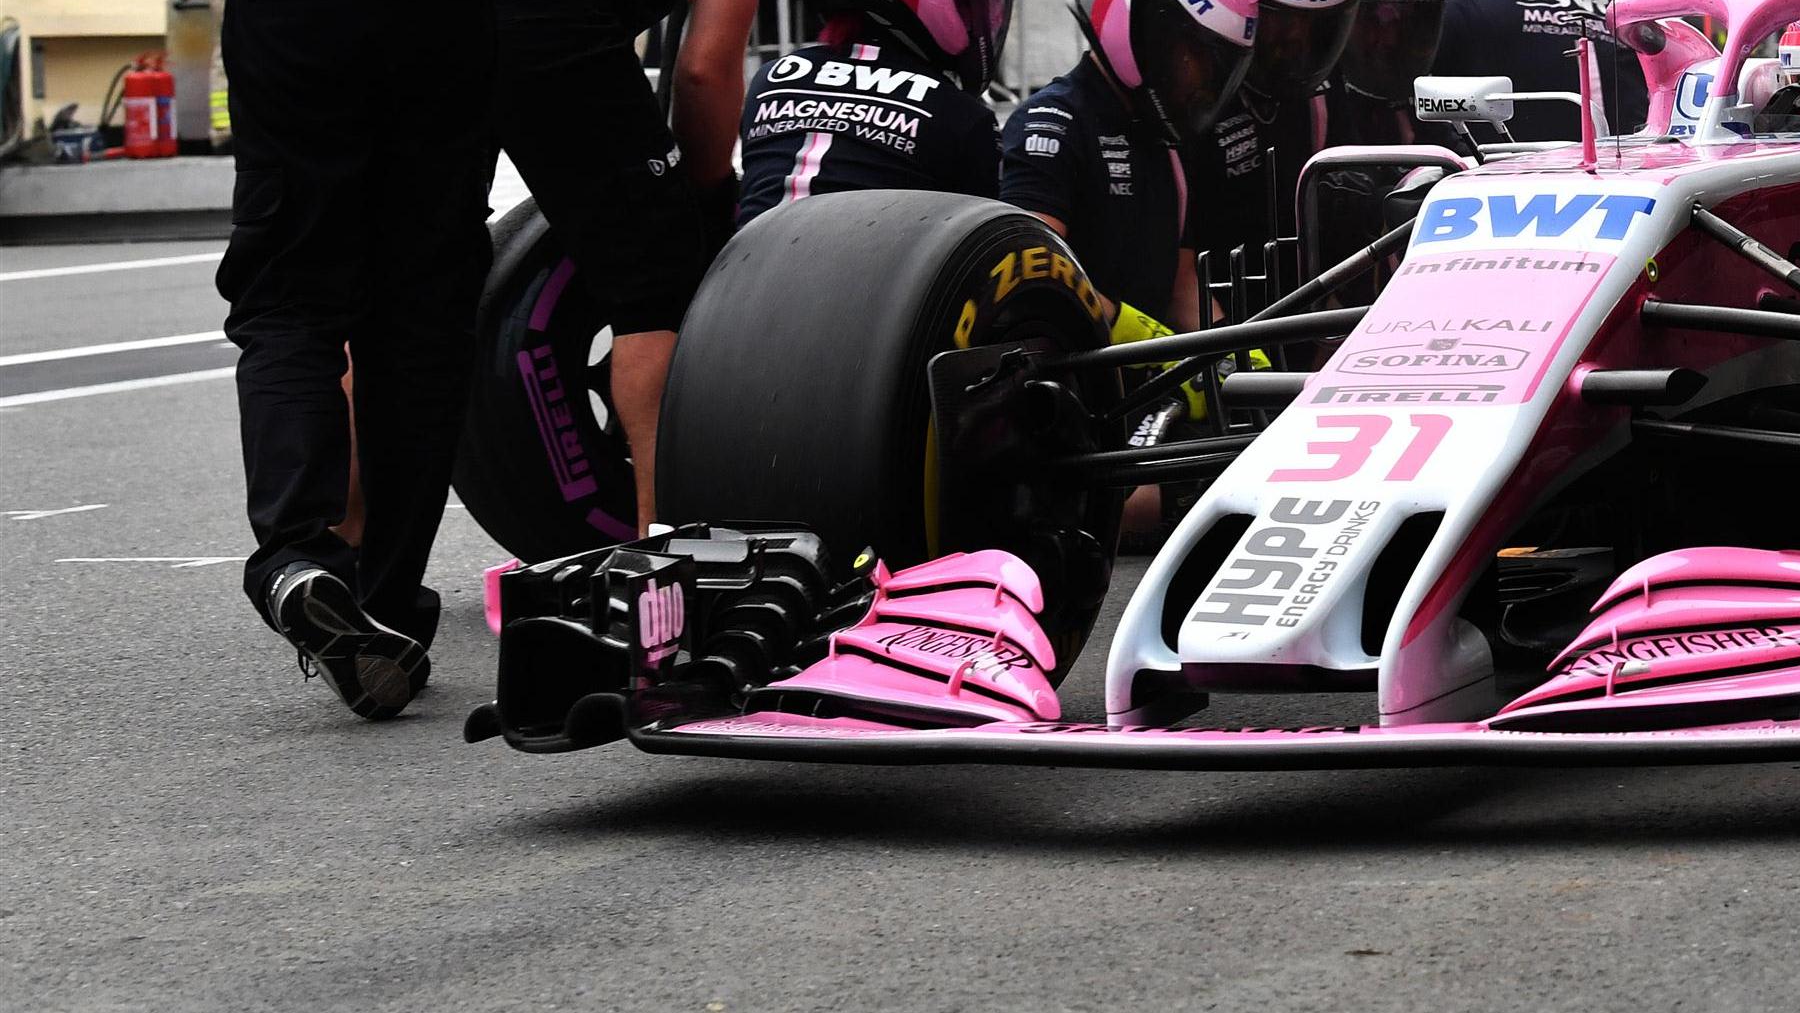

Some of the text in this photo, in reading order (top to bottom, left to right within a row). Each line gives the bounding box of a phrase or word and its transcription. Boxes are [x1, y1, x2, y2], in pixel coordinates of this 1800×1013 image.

[815, 61, 941, 103] BWT
[754, 100, 920, 138] MAGNESIUM
[1418, 97, 1469, 113] PEMEX
[748, 118, 917, 155] MINERALIZED WATER
[1024, 134, 1061, 155] duo
[1226, 155, 1262, 178] NEC
[1109, 182, 1134, 196] NEC
[1413, 194, 1657, 247] BWT
[1402, 256, 1600, 276] infinitum
[1365, 319, 1553, 335] URALKALI
[1353, 354, 1509, 368] SOFINA
[1310, 384, 1506, 404] PIRELLI
[517, 344, 599, 503] PIRELLI
[1266, 414, 1453, 482] 31
[1191, 497, 1352, 626] HYPE
[1276, 501, 1381, 627] ENERGY DRINKS
